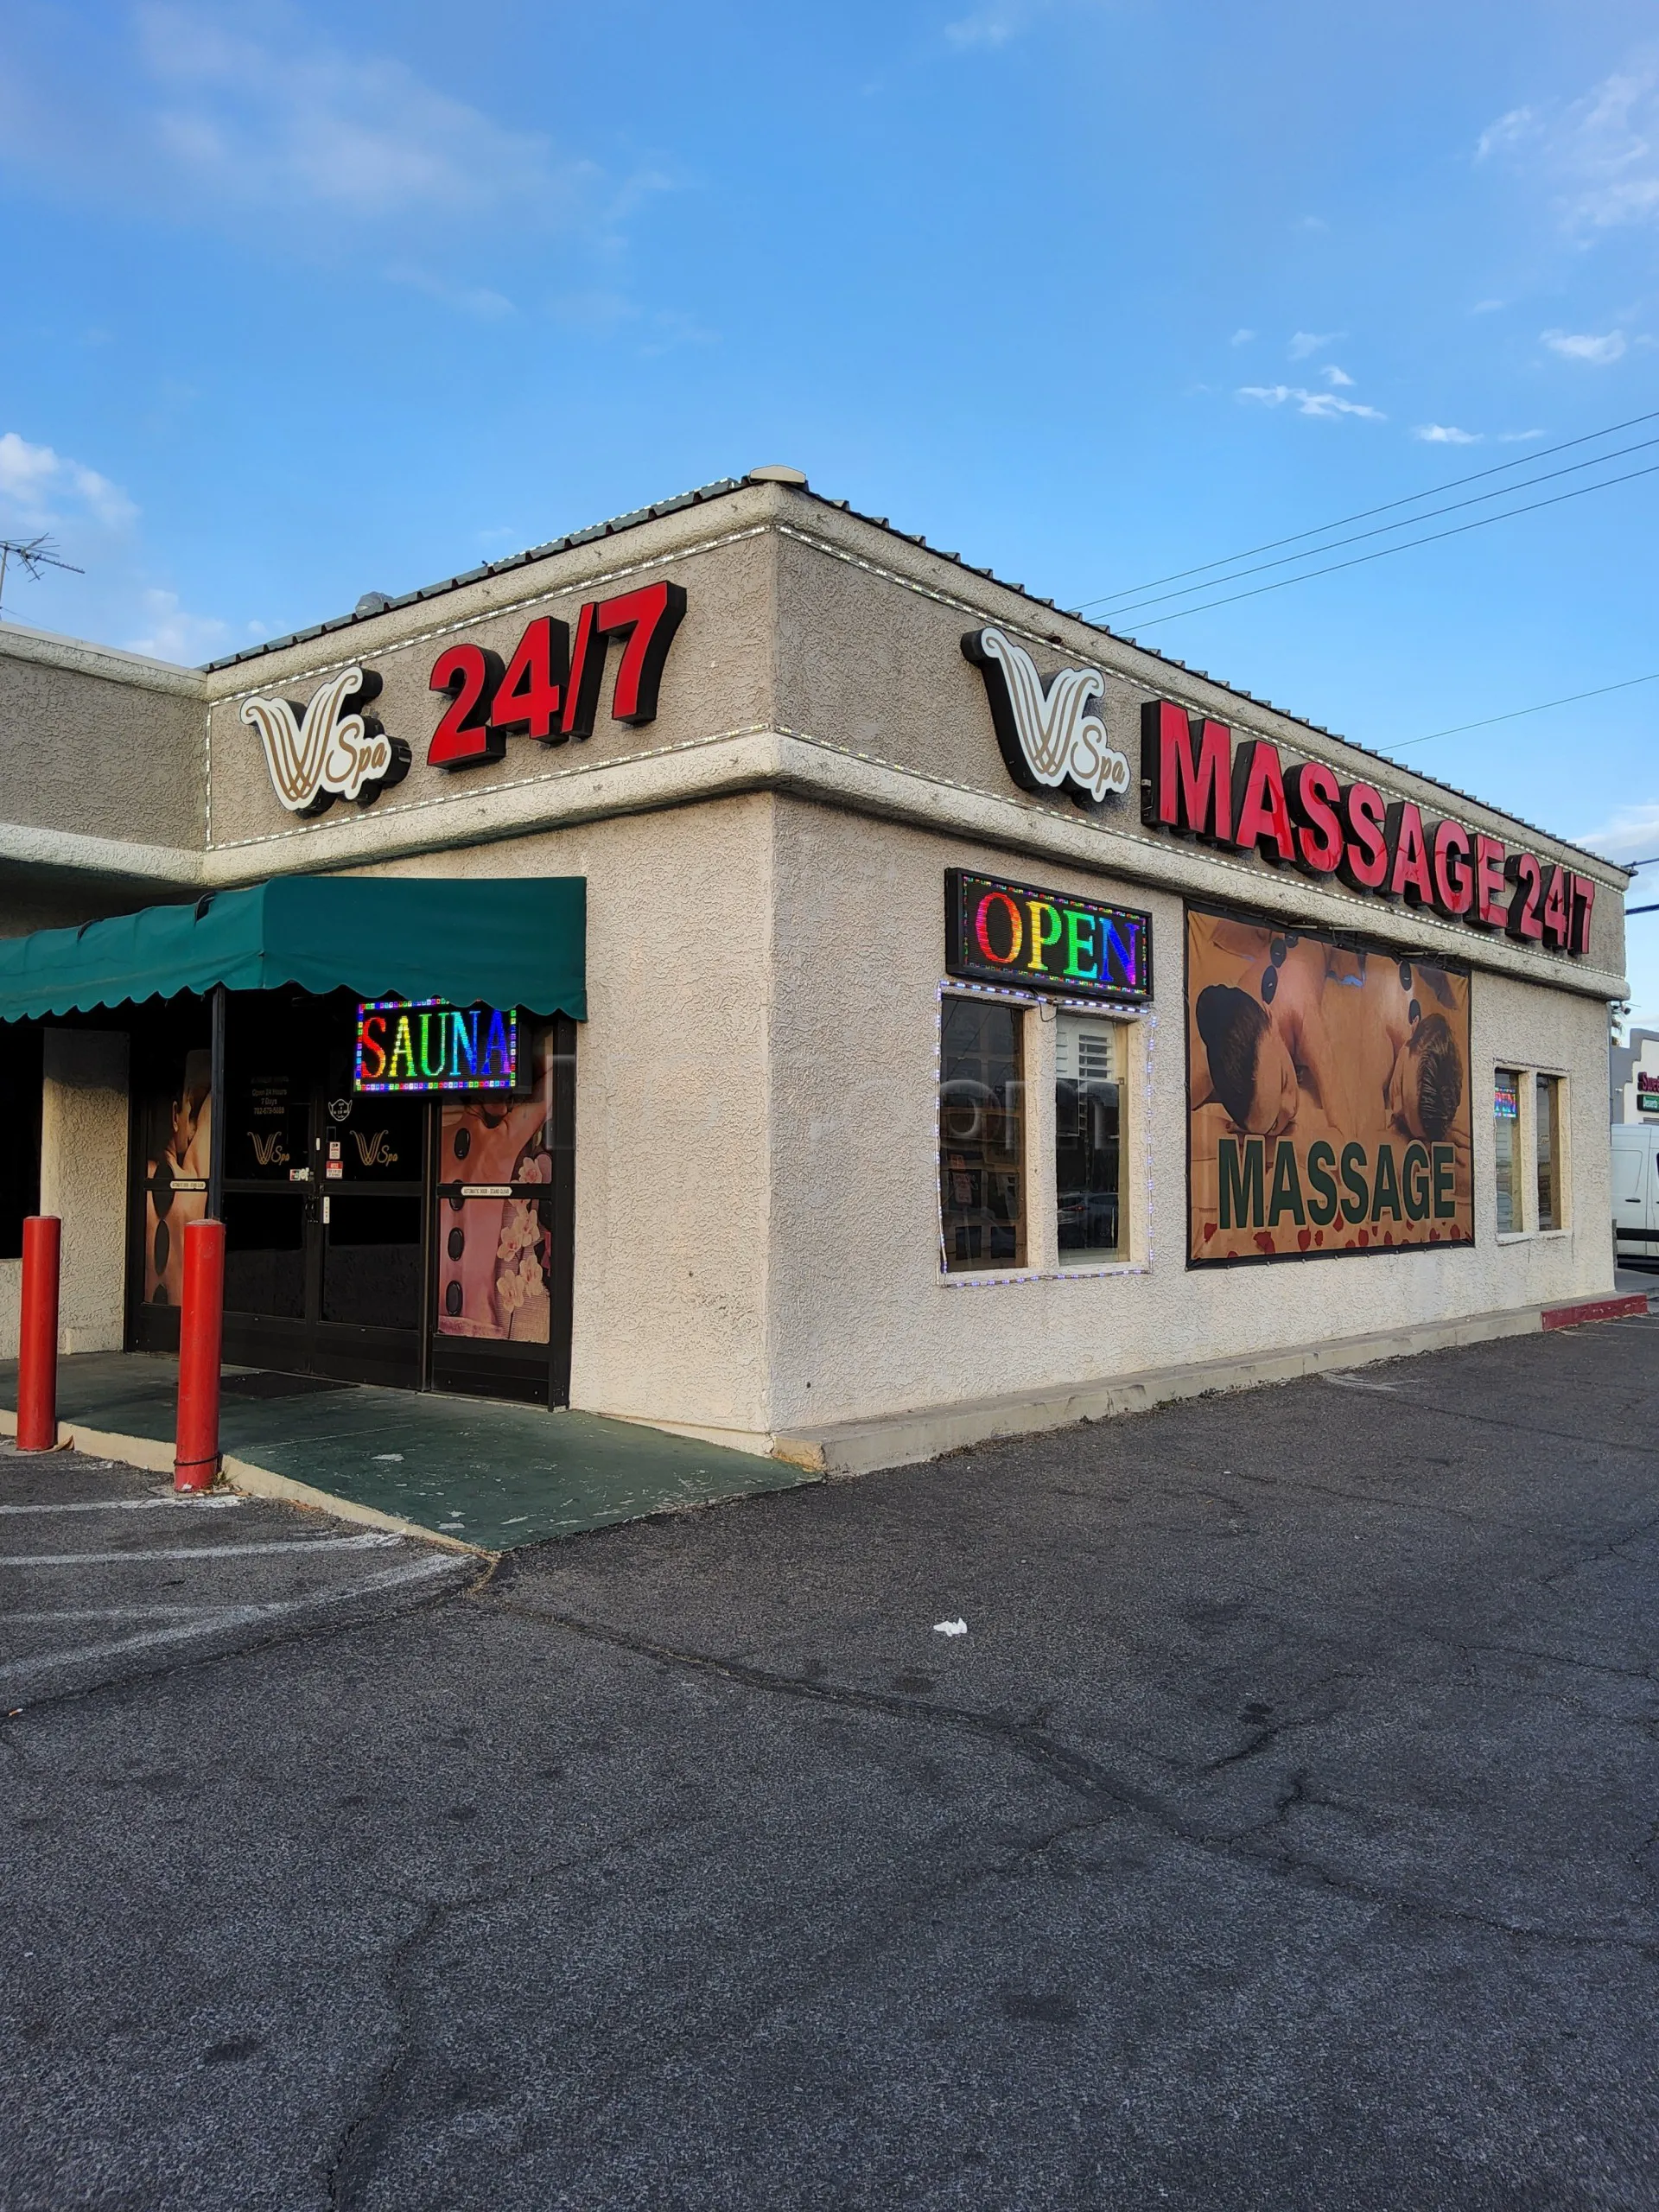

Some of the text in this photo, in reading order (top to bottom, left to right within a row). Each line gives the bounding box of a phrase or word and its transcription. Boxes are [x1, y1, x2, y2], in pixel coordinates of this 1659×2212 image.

[428, 580, 668, 766] 24/7
[325, 722, 388, 790] Spa
[1070, 724, 1126, 793] Spa
[1159, 699, 1596, 955] MASSAGE 24/7
[975, 891, 1141, 985] OPEN
[360, 1008, 512, 1078] SAUNA
[271, 1145, 290, 1166] Spa
[377, 1145, 398, 1166] Spa
[1217, 1137, 1456, 1230] MASSAGE
